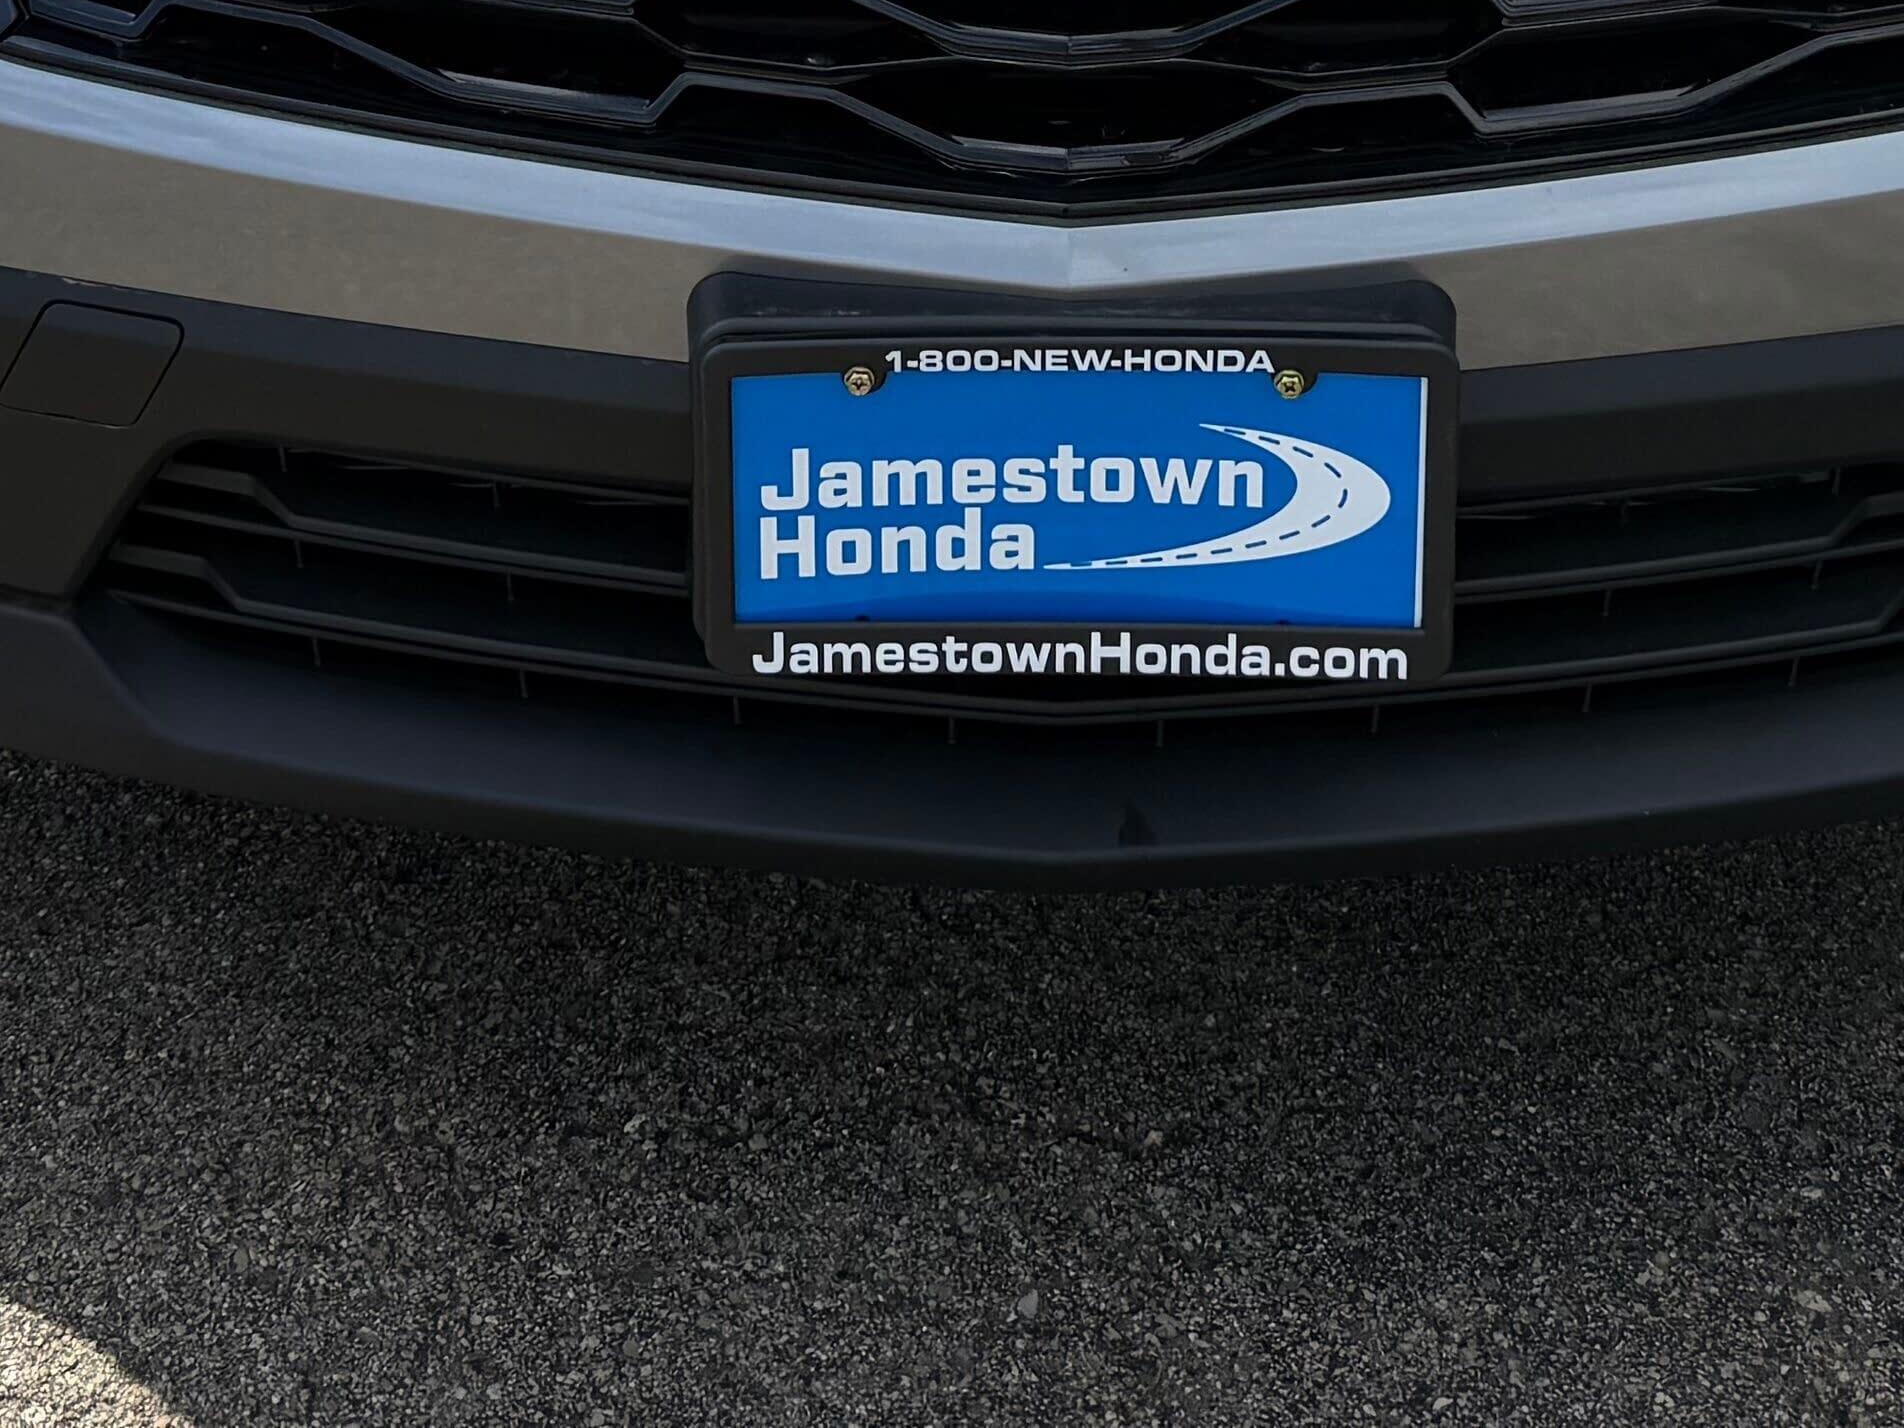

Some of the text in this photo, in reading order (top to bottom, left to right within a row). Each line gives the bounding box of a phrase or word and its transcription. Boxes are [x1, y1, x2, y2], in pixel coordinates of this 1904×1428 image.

[884, 348, 1276, 375] 1-800-NEW-HONDA
[759, 444, 1265, 512] Jamestown
[758, 508, 1037, 580] Honda
[751, 631, 1408, 681] JamestownHonda.com
